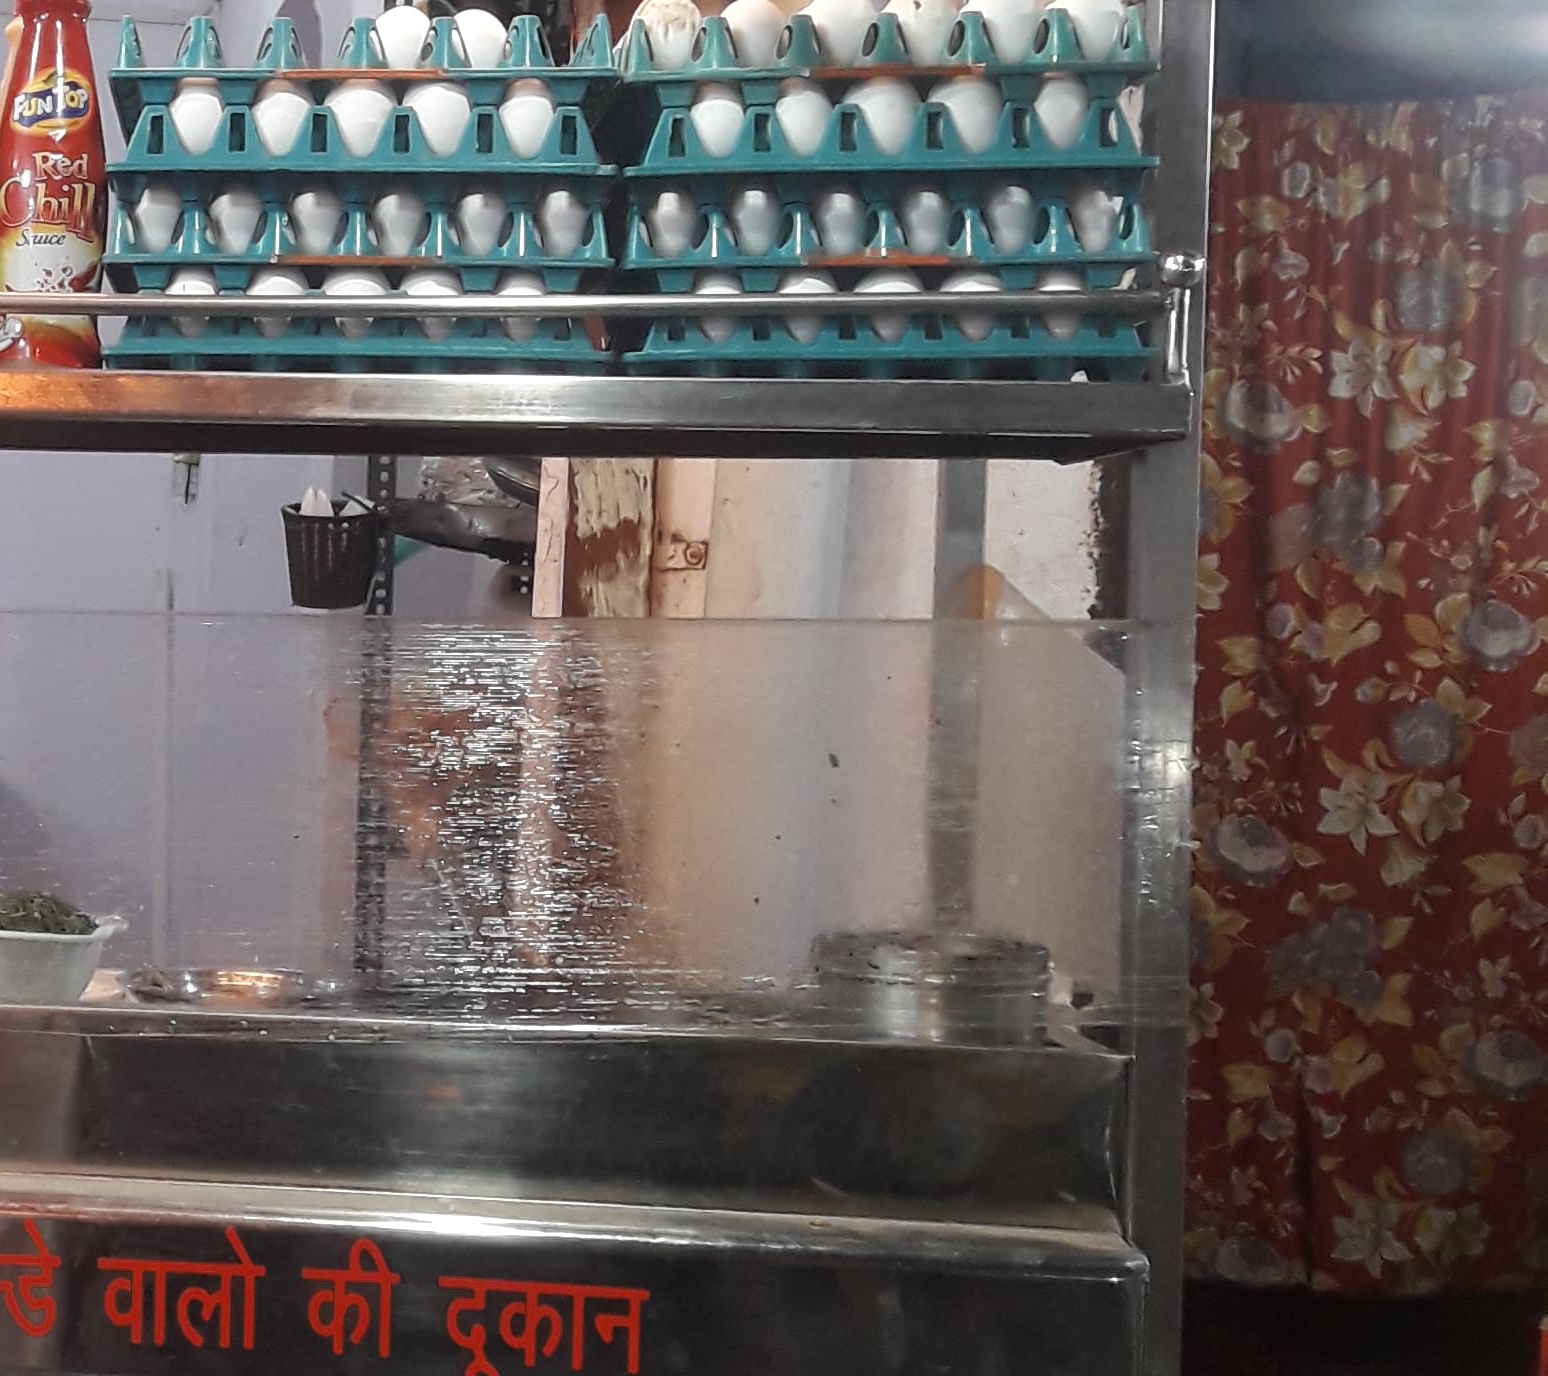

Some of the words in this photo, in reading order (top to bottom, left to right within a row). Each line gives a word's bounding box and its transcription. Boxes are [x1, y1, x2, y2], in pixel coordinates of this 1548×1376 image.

[32, 151, 89, 182] Red
[98, 1226, 266, 1350] वालो
[302, 1238, 401, 1359] की
